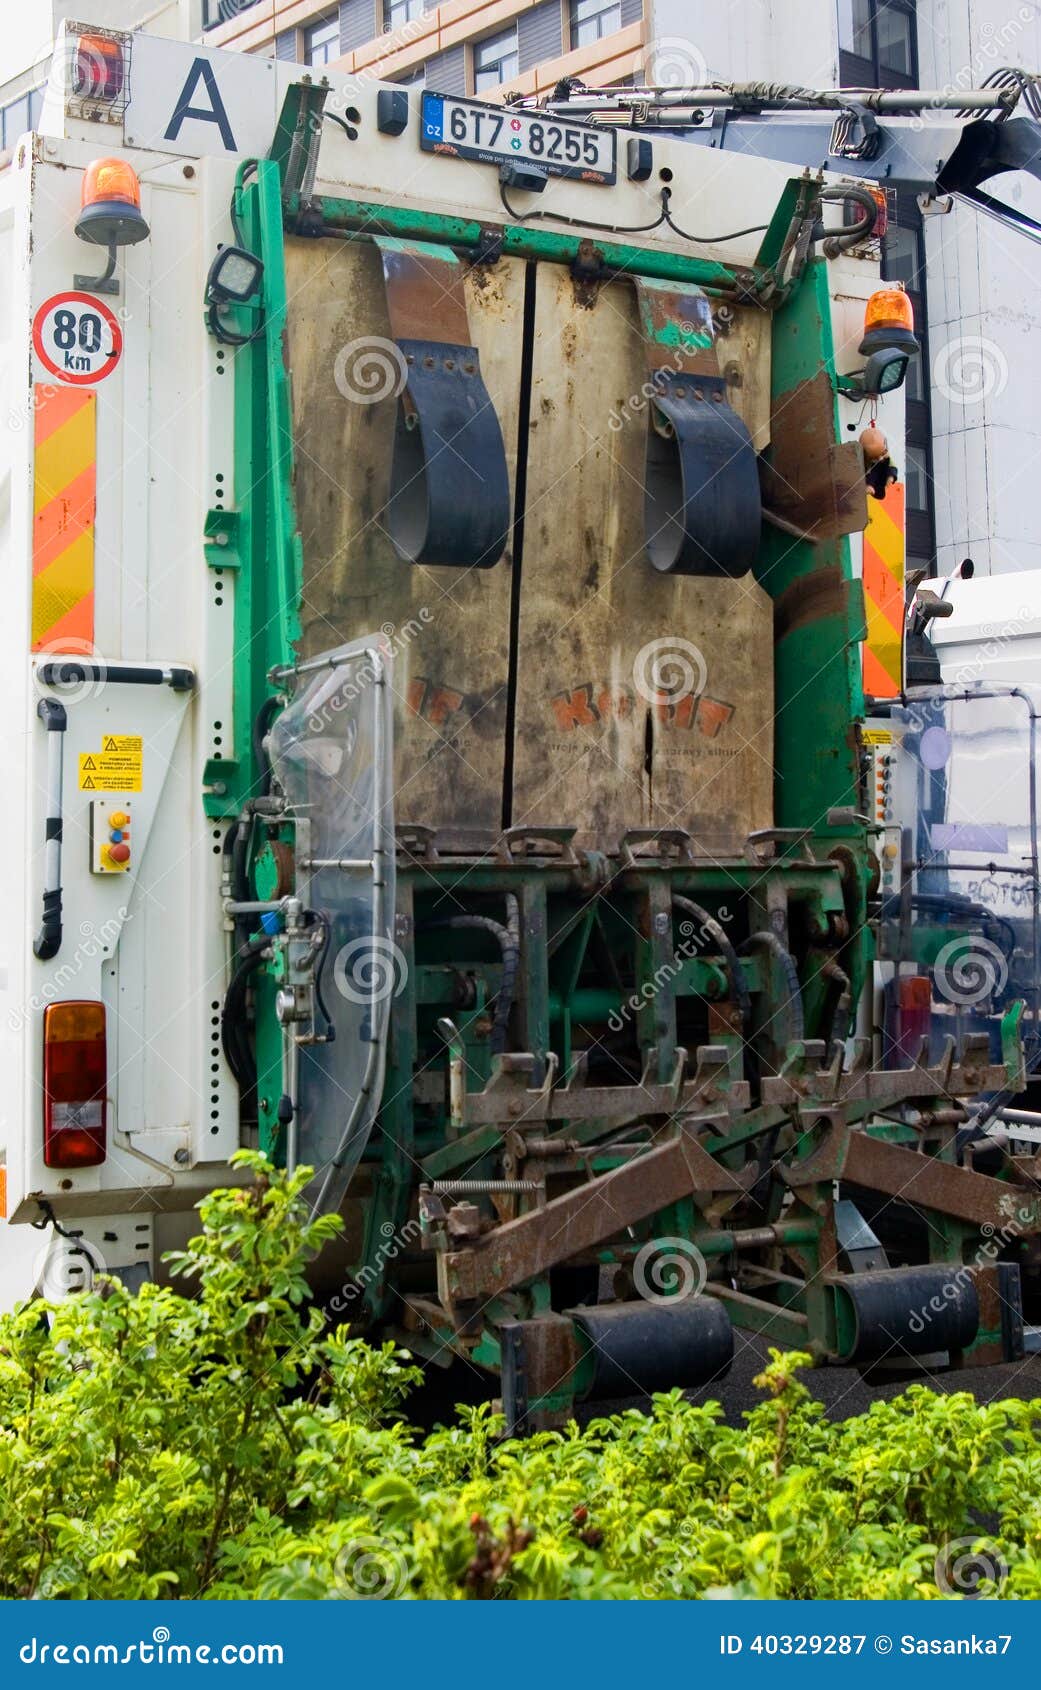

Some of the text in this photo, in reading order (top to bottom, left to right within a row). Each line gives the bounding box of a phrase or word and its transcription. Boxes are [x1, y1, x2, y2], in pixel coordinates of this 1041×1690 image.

[163, 57, 238, 152] A
[427, 124, 441, 137] CZ
[450, 107, 599, 165] 6T7 8255
[53, 309, 101, 353] 80
[64, 351, 91, 371] km
